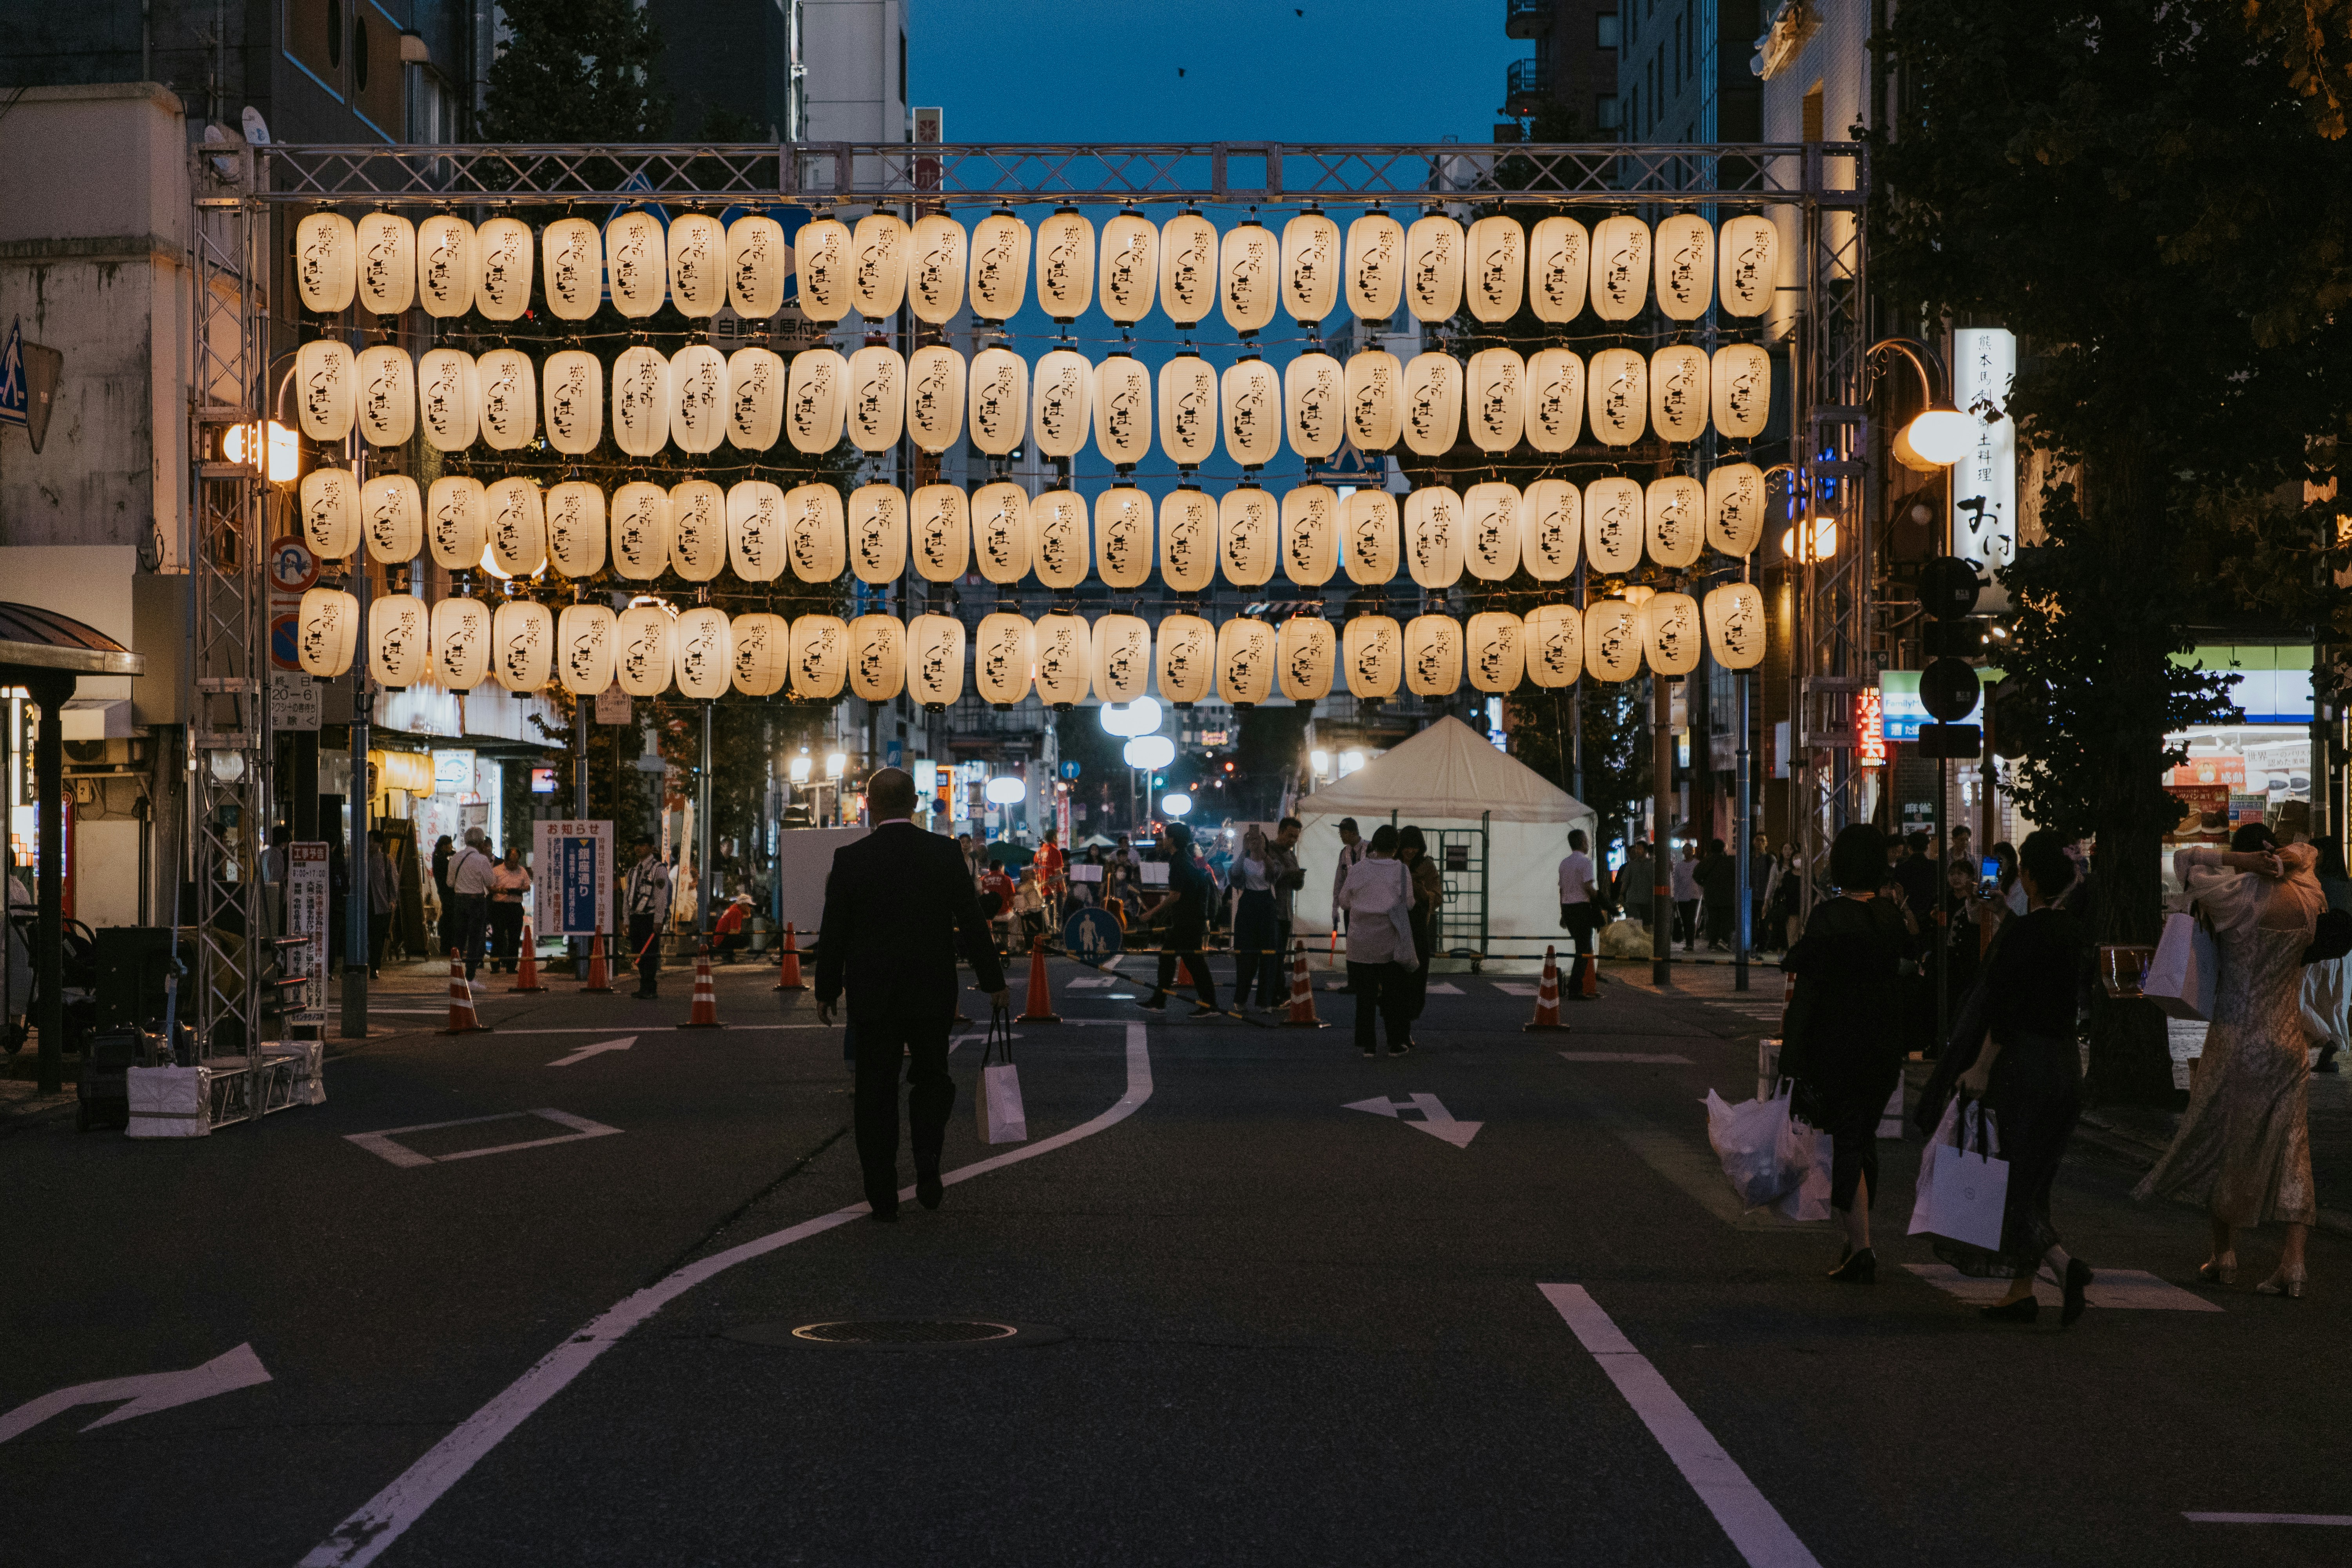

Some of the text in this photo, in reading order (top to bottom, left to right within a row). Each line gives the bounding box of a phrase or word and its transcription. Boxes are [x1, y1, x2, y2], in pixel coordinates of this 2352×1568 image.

[318, 225, 334, 257] 城下町
[383, 226, 398, 258] 城下町
[446, 229, 461, 261] 城下町
[504, 232, 519, 261] 城下町
[572, 231, 588, 263] 城下町
[692, 229, 707, 260] 城下町
[825, 233, 838, 265] 城下町
[941, 232, 956, 263] 城下町
[1065, 227, 1080, 257] 城下町
[1194, 232, 1209, 261] 城下町
[1314, 230, 1329, 260] 城下町
[1436, 232, 1451, 262] 城下町
[1503, 232, 1517, 261] 城下町
[1565, 233, 1580, 263] 城下町
[1691, 230, 1705, 260] 城下町
[303, 244, 323, 296] くまもと
[367, 243, 388, 298] くまもと
[428, 247, 450, 301] くまもと
[485, 250, 507, 305] くまもと
[555, 249, 578, 303] くまもと
[677, 247, 698, 302] くまもと
[808, 251, 831, 306] くまもと
[919, 250, 942, 305] くまもと
[1047, 245, 1069, 301] くまもと
[1174, 249, 1197, 305] くまもと
[1293, 247, 1316, 303] くまもと
[1416, 250, 1438, 305] くまもと
[1483, 249, 1506, 305] くまもと
[1544, 251, 1568, 306] くまもと
[1670, 247, 1694, 303] くまもと
[383, 359, 399, 389] 城下町
[502, 363, 517, 392] 城下町
[640, 358, 658, 408] 城下町
[701, 362, 718, 408] 城下町
[753, 363, 769, 395] 城下町
[878, 362, 893, 394] 城下町
[998, 366, 1014, 398] 城下町
[1127, 374, 1141, 407] 城下町
[1251, 376, 1265, 407] 城下町
[1373, 368, 1388, 399] 城下町
[1503, 364, 1515, 393] 城下町
[1561, 365, 1573, 393] 城下町
[1626, 362, 1637, 390] 城下町
[1749, 358, 1760, 384] 城下町
[368, 378, 390, 432] くまもと
[487, 381, 508, 434] くまもと
[621, 377, 636, 429] くまもと
[681, 377, 697, 429] くまもと
[734, 380, 756, 435] くまもと
[858, 380, 881, 435] くまもと
[978, 383, 1000, 438] くまもと
[1354, 385, 1376, 437] くまもと
[1483, 381, 1506, 436] くまもと
[1539, 381, 1563, 436] くまもと
[1606, 379, 1629, 430] くまもと
[1730, 374, 1750, 423] くまもと
[1109, 392, 1132, 449] くまもと
[1234, 393, 1256, 448] くまもと
[324, 481, 339, 510] 城下町
[389, 493, 402, 515] 城下町
[452, 490, 467, 517] 城下町
[565, 495, 580, 525] 城下町
[695, 494, 710, 525] 城下町
[807, 497, 822, 529] 城下町
[940, 497, 956, 528] 城下町
[1310, 499, 1325, 531] 城下町
[1372, 503, 1387, 530] 城下町
[1561, 494, 1574, 522] 城下町
[1676, 489, 1691, 515] 城下町
[310, 499, 332, 546] くまもと
[373, 505, 394, 550] くまもと
[436, 505, 457, 555] くまもと
[552, 513, 571, 563] くまもと
[678, 512, 700, 566] くまもと
[1058, 505, 1073, 535] 城下町
[1187, 505, 1203, 536] 城下町
[1432, 505, 1451, 549] 城下町
[1541, 511, 1564, 565] くまもと
[1657, 505, 1679, 551] くまもと
[794, 517, 815, 570] くまもと
[924, 515, 947, 568] くまもと
[1043, 522, 1065, 574] くまもと
[1170, 523, 1191, 576] くまもと
[1292, 517, 1313, 571] くまもと
[1356, 519, 1379, 568] くまもと
[1416, 521, 1431, 568] くまもと
[401, 612, 416, 638] 城下町
[1620, 613, 1633, 637] 城下町
[1740, 597, 1754, 621] 城下町
[381, 627, 404, 675] くまもと
[526, 619, 541, 647] 城下町
[644, 624, 660, 654] 城下町
[751, 625, 766, 651] 城下町
[877, 628, 891, 654] 城下町
[1004, 628, 1017, 653] 城下町
[1377, 630, 1389, 653] 城下町
[1498, 626, 1513, 653] 城下町
[1601, 626, 1621, 668] くまもと
[1724, 613, 1744, 655] くまもと
[507, 634, 529, 681] くまもと
[626, 639, 647, 683] くまもと
[736, 639, 755, 682] くまもと
[860, 642, 882, 687] くまもと
[986, 643, 1007, 688] くまもと
[1358, 644, 1381, 684] くまもと
[1480, 641, 1500, 684] くまもと
[1890, 723, 1902, 736] 酒
[548, 824, 599, 835] お知らせ
[989, 828, 996, 838] P
[294, 848, 324, 859] 工事予告
[578, 848, 590, 897] 銀座通り
